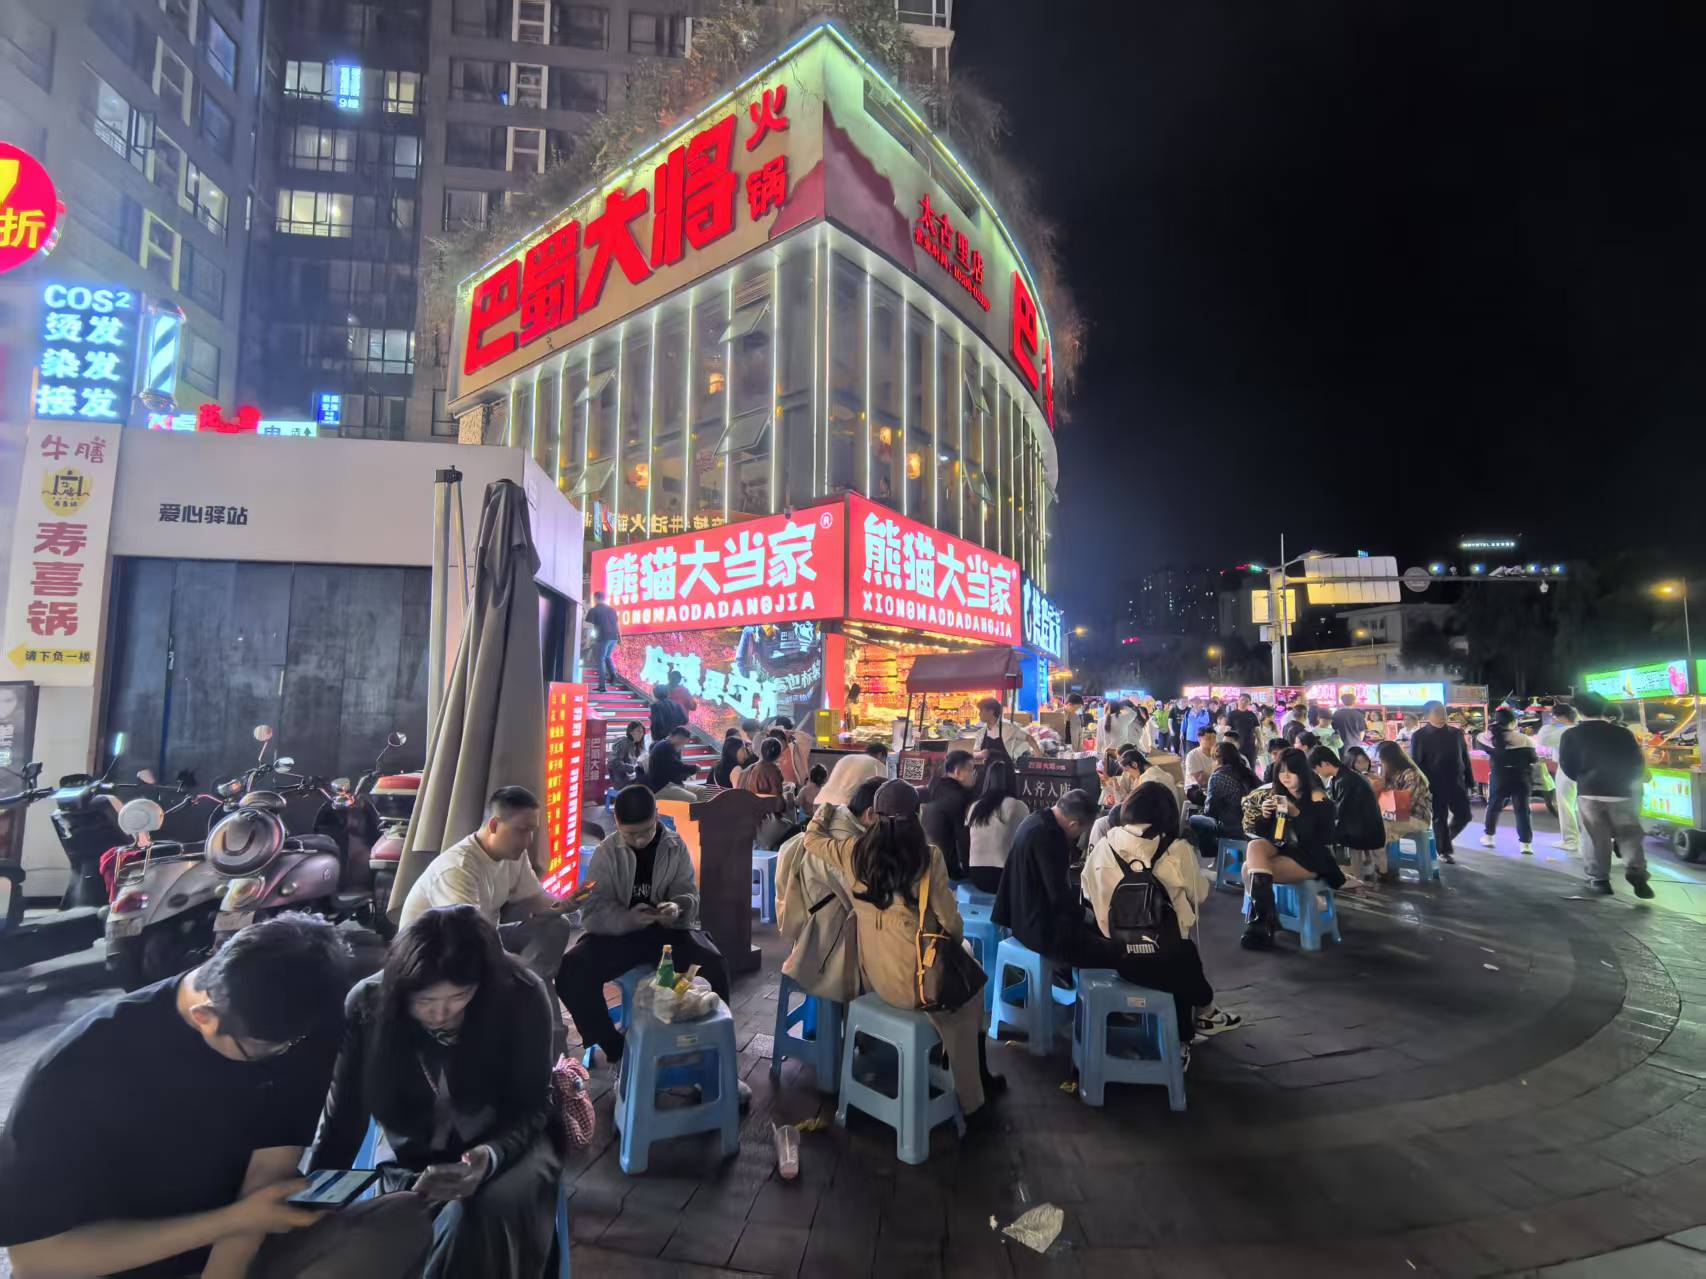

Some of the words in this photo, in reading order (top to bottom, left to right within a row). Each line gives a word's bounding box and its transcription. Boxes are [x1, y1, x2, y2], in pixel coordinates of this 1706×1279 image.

[746, 84, 788, 222] 火锅
[464, 114, 738, 375] 巴蜀大将
[44, 312, 124, 346] 烫发
[41, 348, 121, 381] 染发
[36, 384, 118, 417] 接发
[159, 504, 248, 525] 爱心驿站
[26, 522, 88, 636] 寿喜锅
[605, 522, 817, 606] 熊猫大当家
[863, 512, 1012, 616] 熊猫大当家
[617, 591, 815, 626] ONGMAODADANGJIA
[863, 591, 1012, 638] XIONGMAODADANGJIA
[25, 650, 91, 662] 请下负一楼
